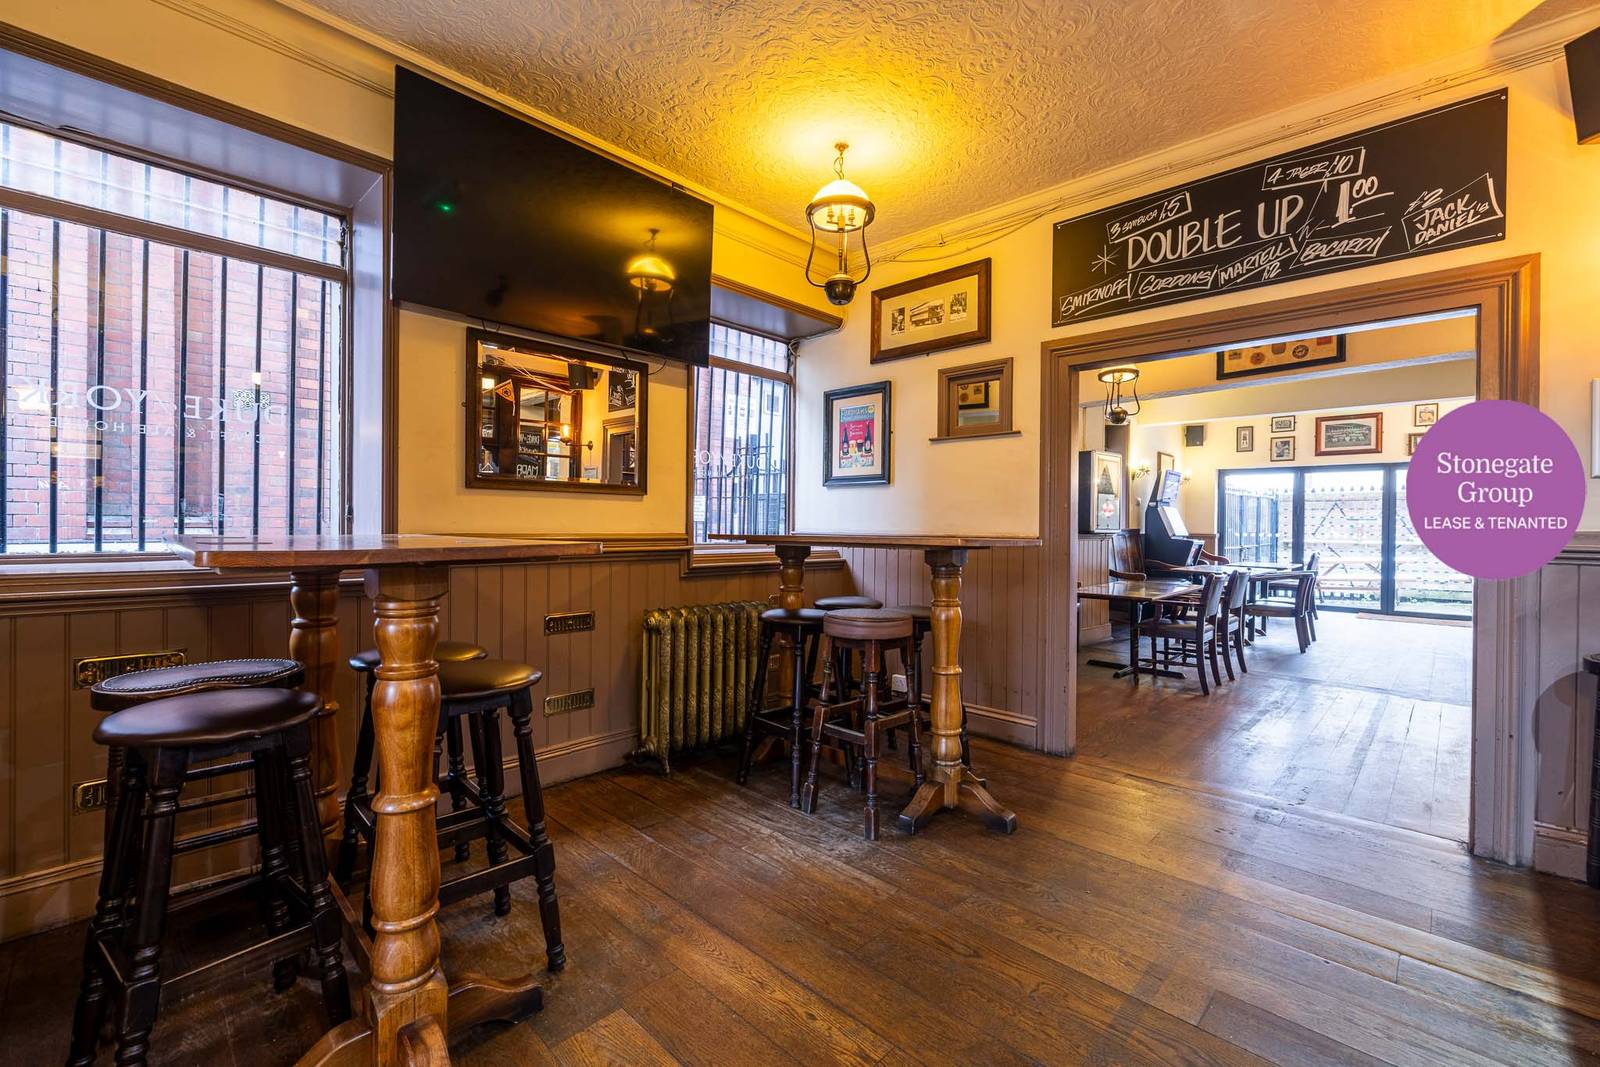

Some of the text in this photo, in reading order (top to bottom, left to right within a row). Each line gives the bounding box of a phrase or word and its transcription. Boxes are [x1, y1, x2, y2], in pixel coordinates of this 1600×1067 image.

[1267, 167, 1284, 184] 4
[1286, 161, 1329, 180] JAGER
[1413, 193, 1478, 231] JACK
[1110, 222, 1121, 240] 3
[1127, 209, 1242, 270] DOUBLE
[1256, 194, 1304, 240] UP
[1220, 242, 1291, 285] MARTELL
[1301, 235, 1381, 262] BACARDI
[1061, 278, 1128, 316] SMIRNOFF
[1138, 270, 1212, 295] GORDONS
